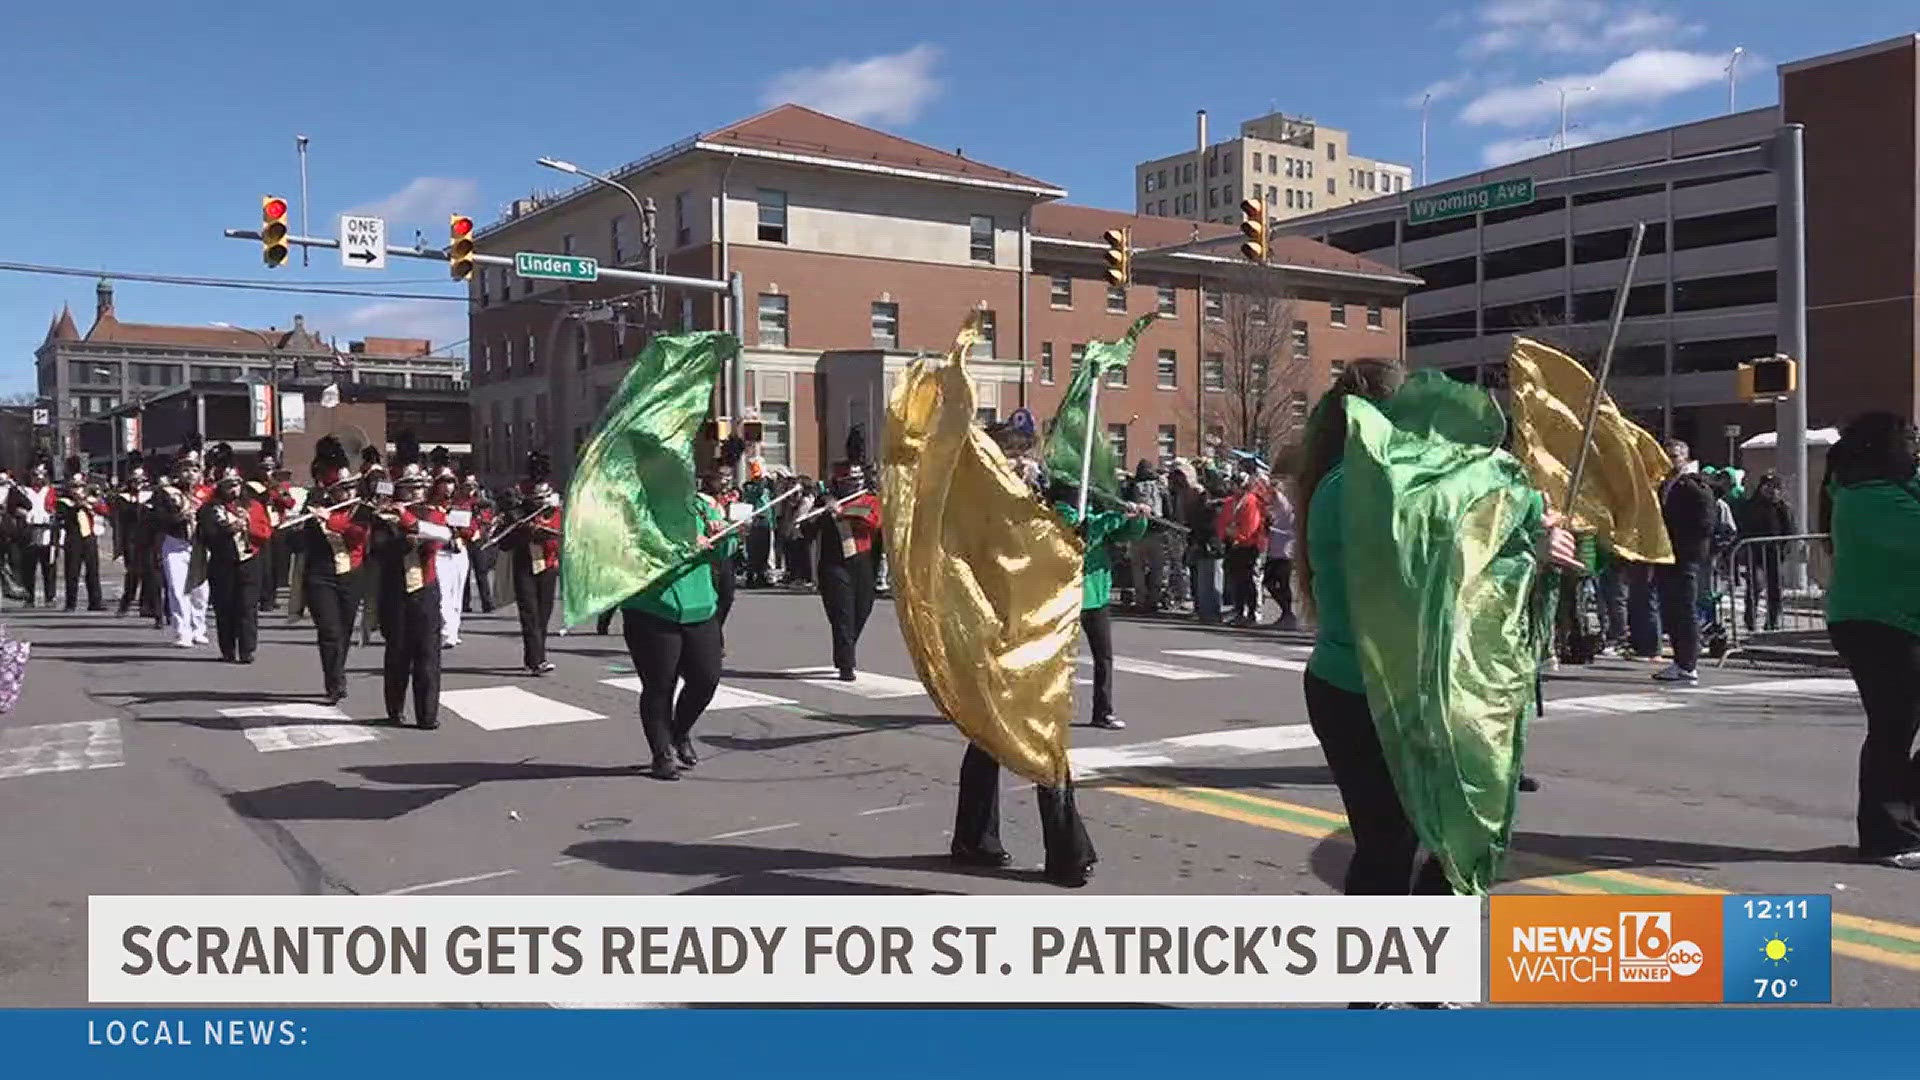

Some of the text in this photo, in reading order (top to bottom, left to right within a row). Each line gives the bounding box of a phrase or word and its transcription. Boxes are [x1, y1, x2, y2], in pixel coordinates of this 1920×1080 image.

[1413, 182, 1528, 217] Wyoming Ave
[348, 219, 378, 233] ONE
[347, 233, 379, 247] WAY
[520, 255, 594, 276] Linden St
